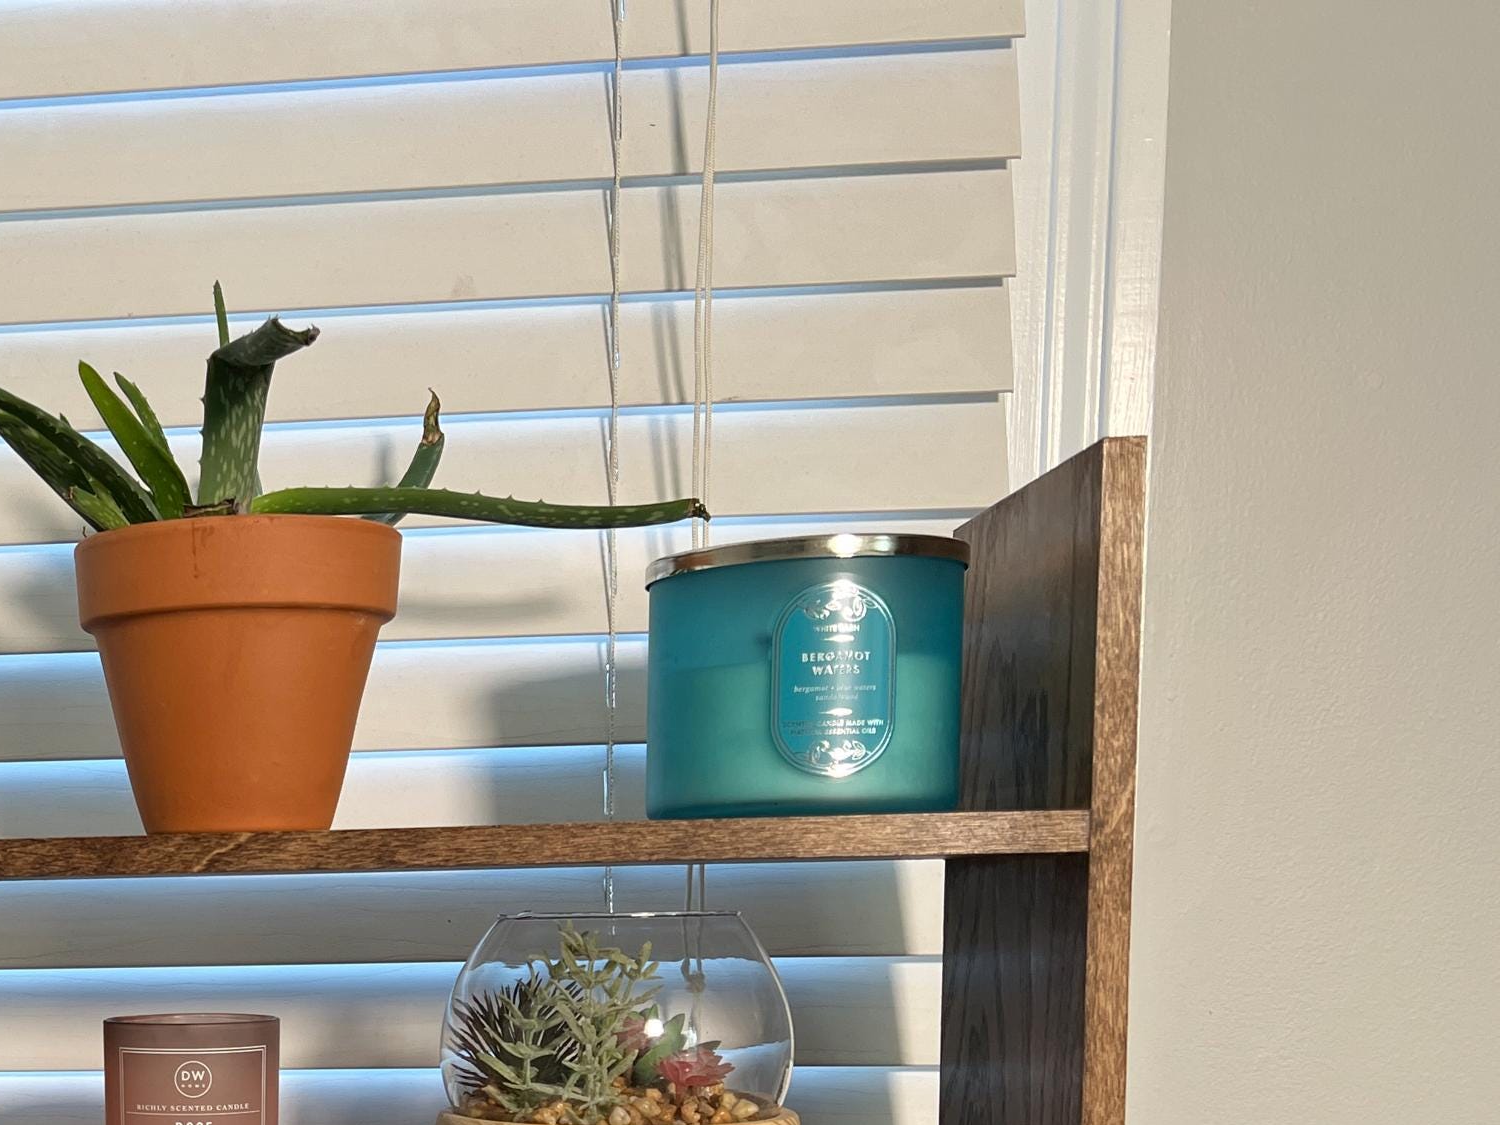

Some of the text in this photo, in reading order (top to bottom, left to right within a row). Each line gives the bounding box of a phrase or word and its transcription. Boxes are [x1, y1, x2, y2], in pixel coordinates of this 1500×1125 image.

[181, 1071, 205, 1081] DW
[136, 1103, 250, 1112] RICHLY SCENTED CANDLE
